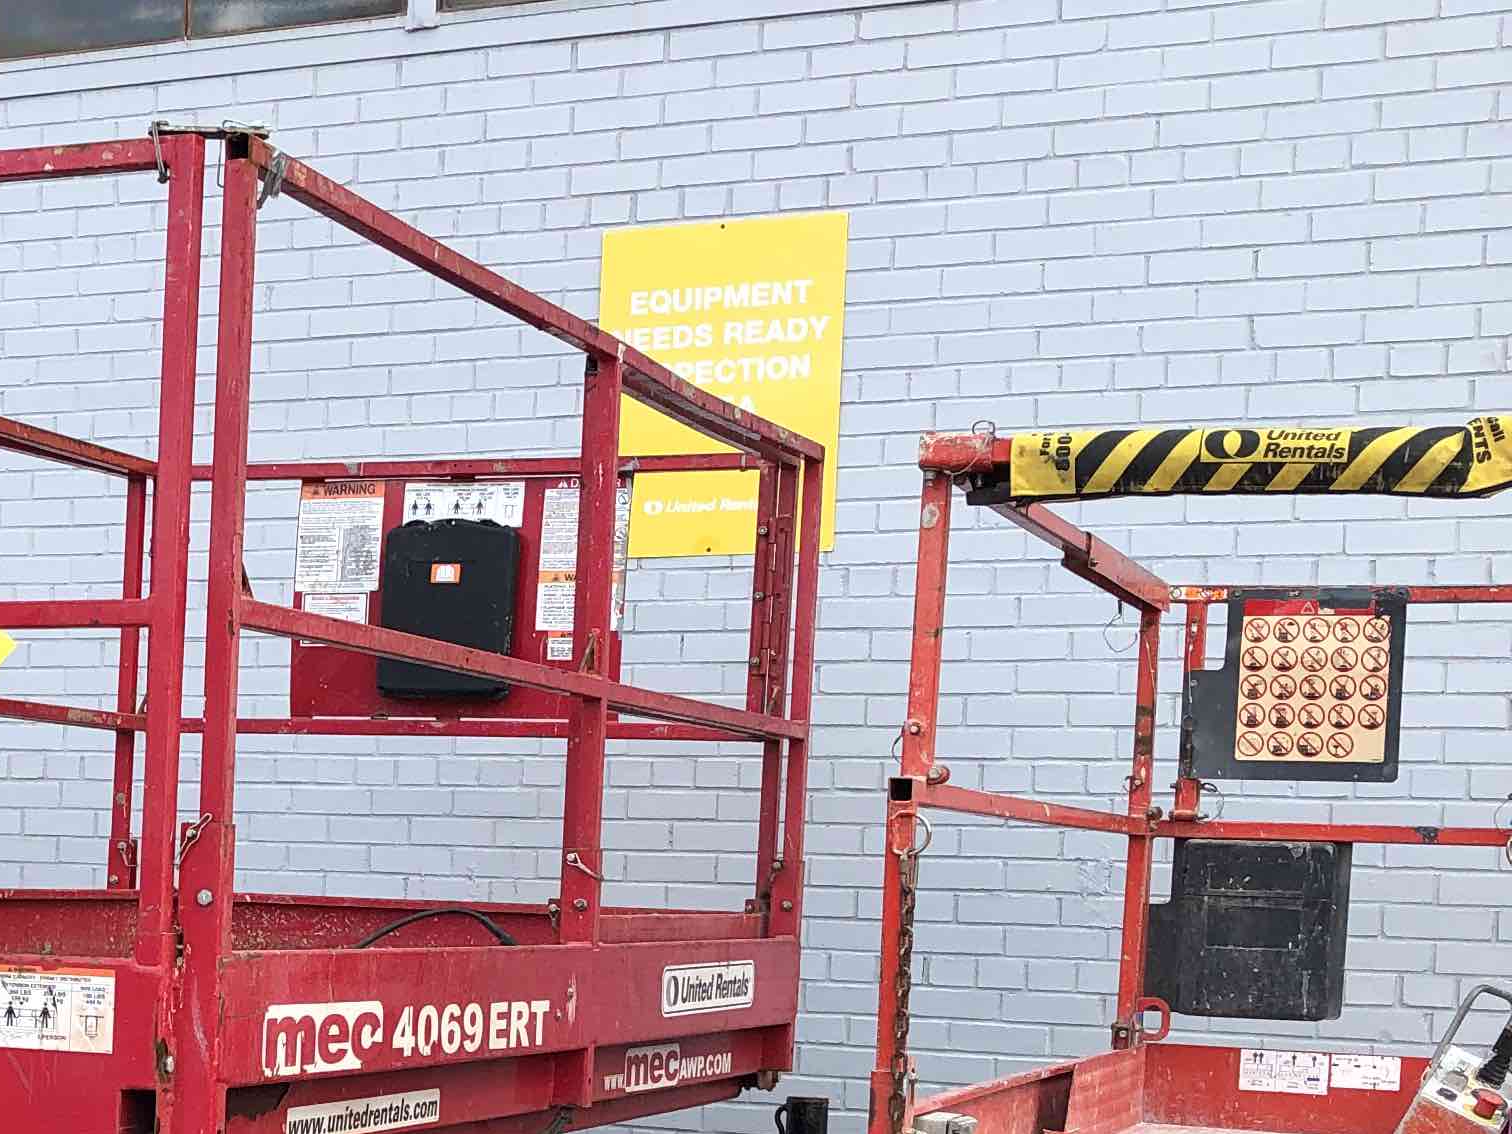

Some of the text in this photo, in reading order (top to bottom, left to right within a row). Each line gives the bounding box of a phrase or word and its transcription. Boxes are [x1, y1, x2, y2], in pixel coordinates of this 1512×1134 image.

[630, 279, 813, 316] EQUIPMENT
[723, 316, 830, 345] READY
[1267, 429, 1342, 441] United
[1263, 442, 1346, 459] Rentals
[323, 483, 377, 497] WARNING
[681, 972, 749, 1003] United Rentals
[264, 1010, 383, 1074] mec
